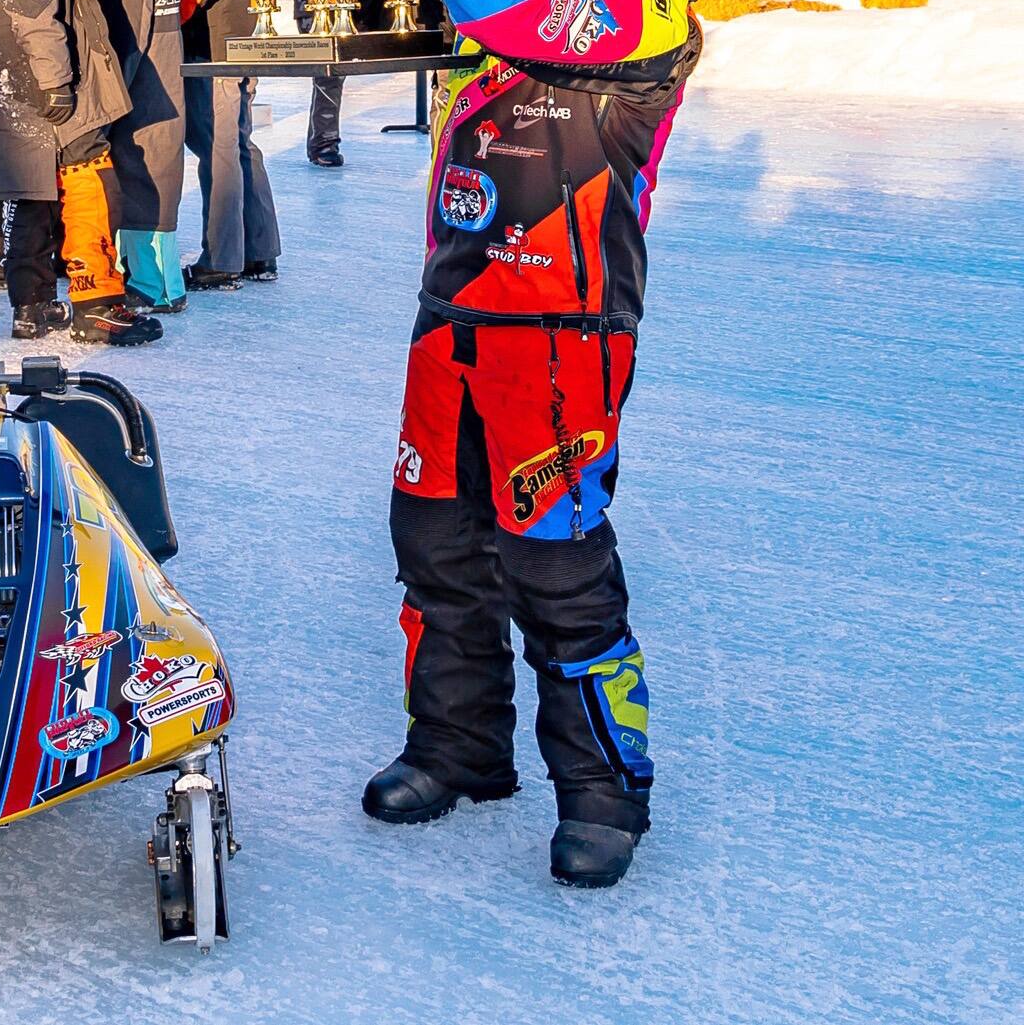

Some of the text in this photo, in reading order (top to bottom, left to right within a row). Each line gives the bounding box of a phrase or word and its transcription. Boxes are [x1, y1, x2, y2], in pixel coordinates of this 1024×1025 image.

[239, 42, 253, 51] Vintage
[265, 41, 292, 50] Championship
[267, 51, 278, 59] Place
[548, 107, 572, 120] AAB
[486, 248, 553, 268] STUD BOY
[395, 439, 424, 484] 79
[121, 654, 197, 704] CHOKO
[146, 684, 218, 720] POWERSPORTS
